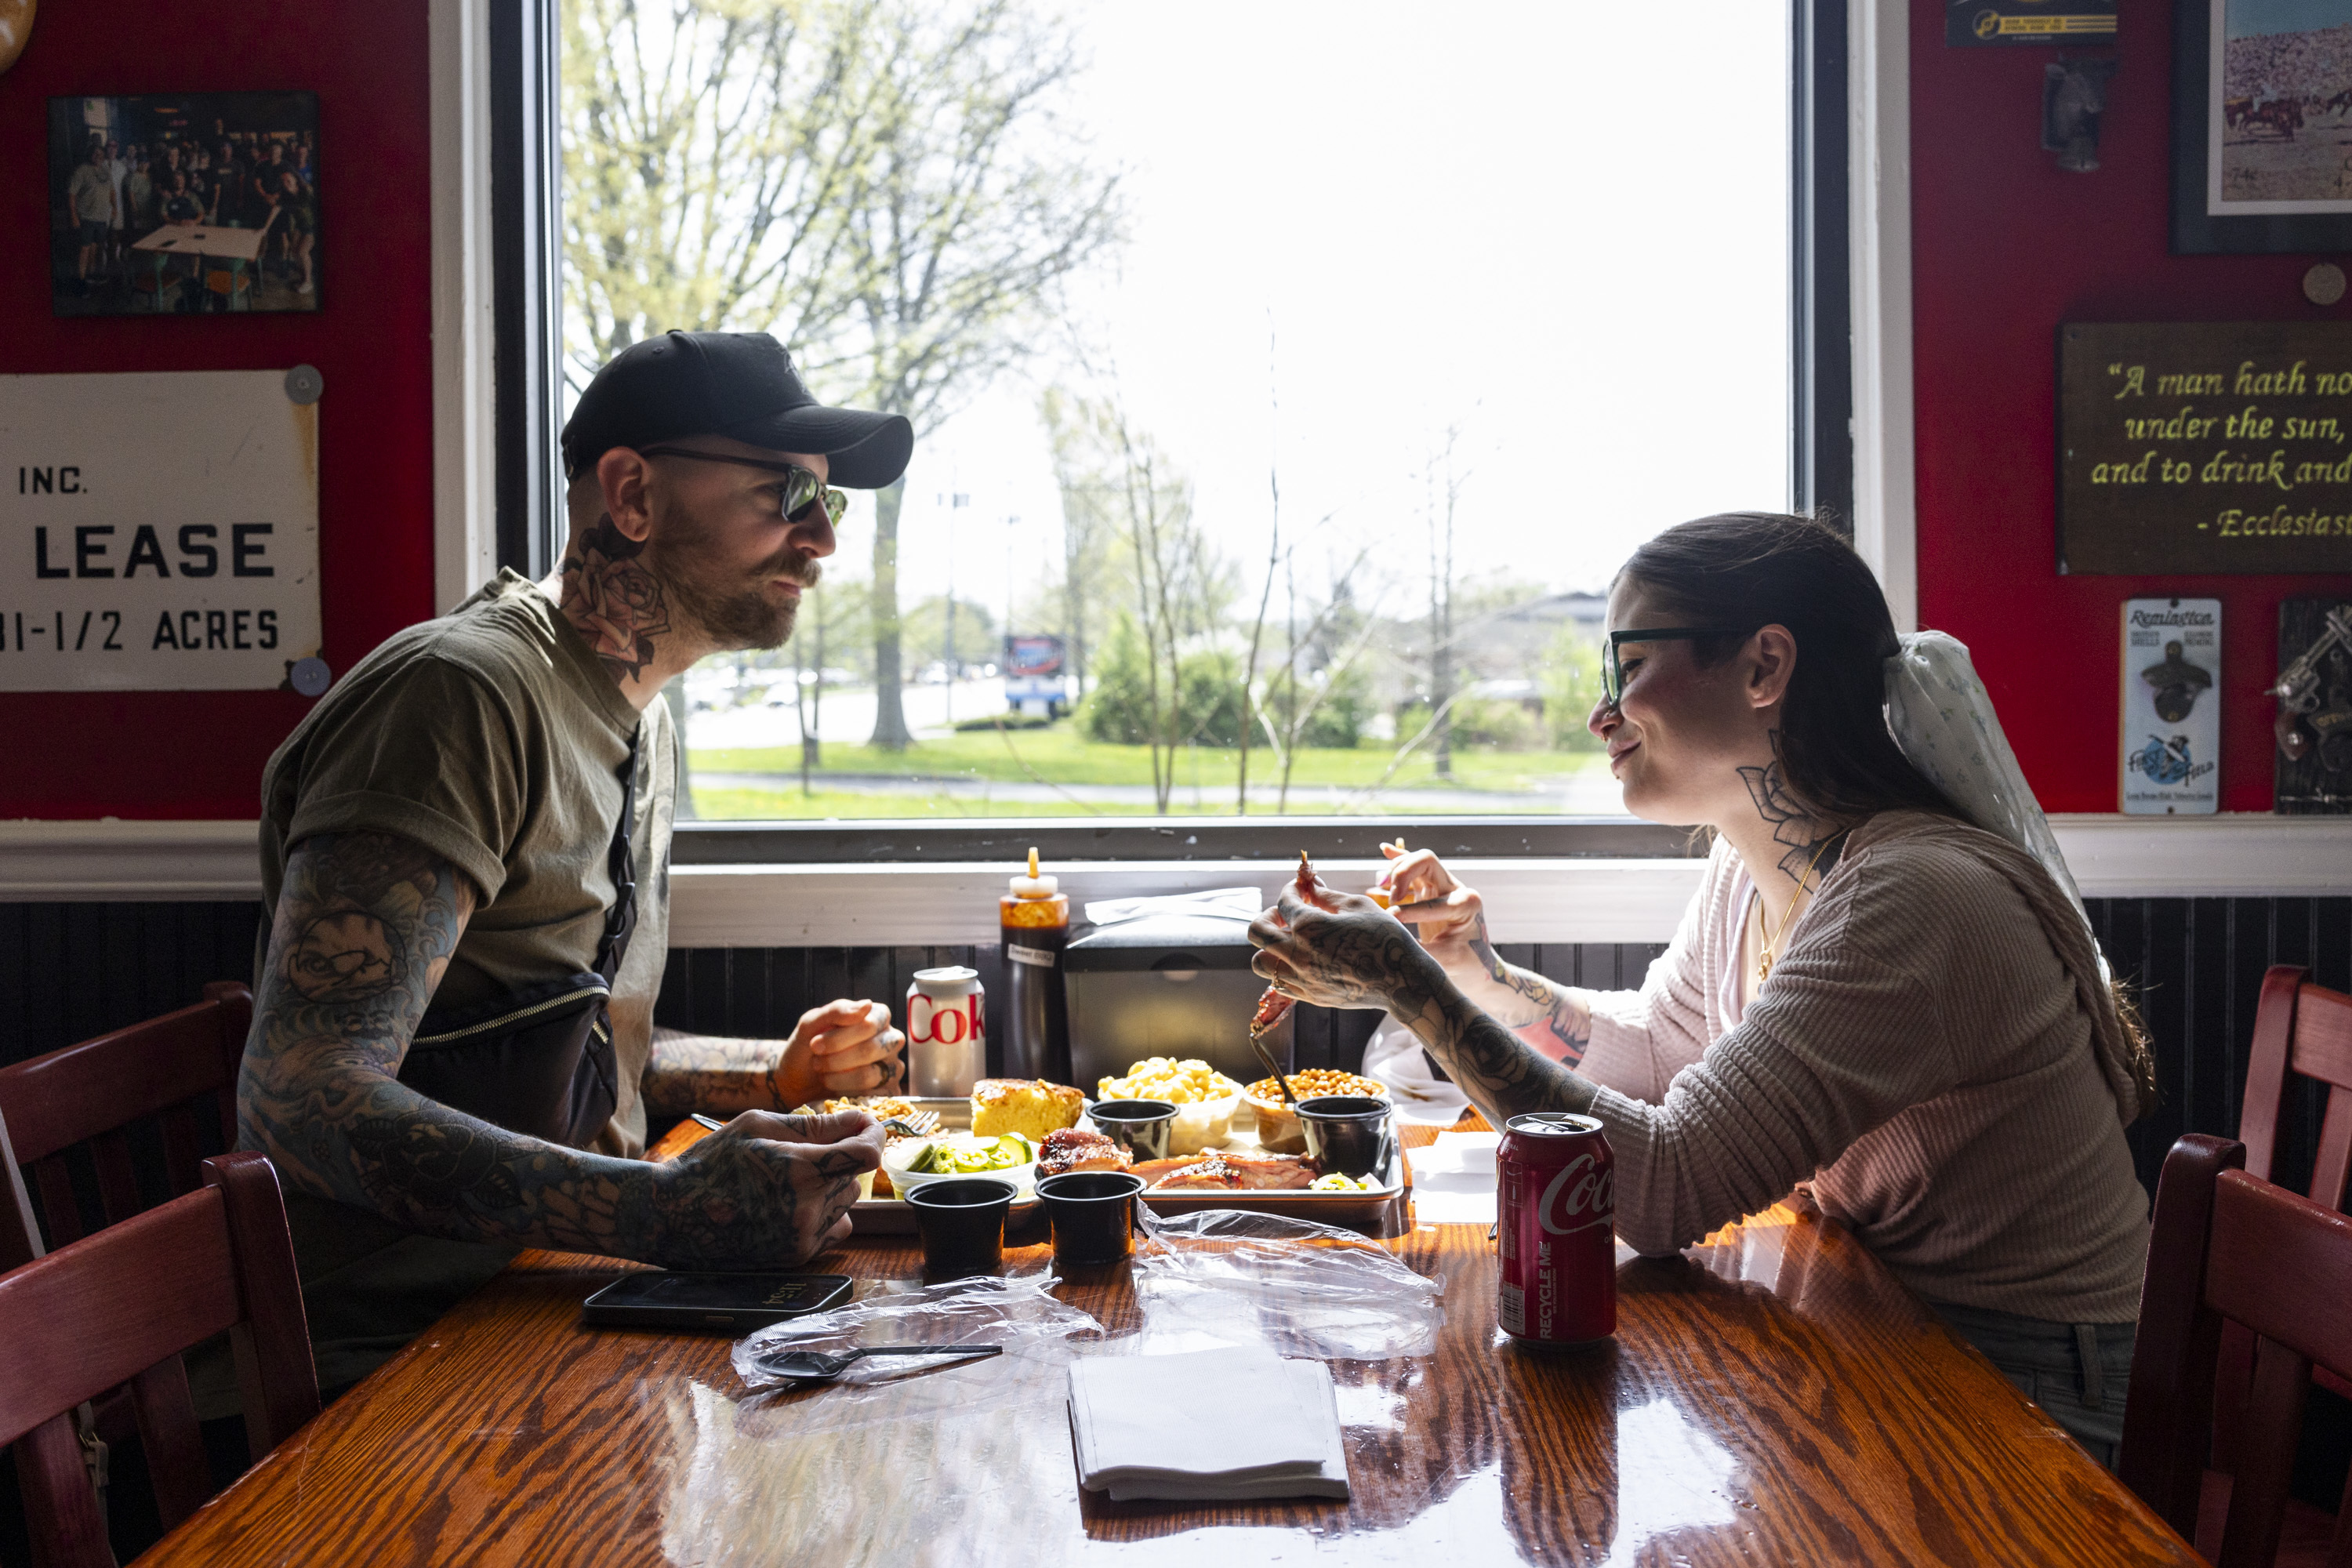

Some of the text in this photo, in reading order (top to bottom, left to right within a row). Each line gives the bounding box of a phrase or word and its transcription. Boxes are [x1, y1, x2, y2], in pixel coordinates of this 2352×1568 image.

[2157, 372, 2224, 396] man
[2234, 361, 2307, 397] hath
[2125, 406, 2345, 444] under the sun,
[19, 467, 88, 495] INC.
[2092, 450, 2352, 490] and to drink and
[35, 523, 275, 579] LEASE
[0, 610, 278, 652] 1-1/2 ACRES
[1539, 1241, 1552, 1340] RECYCLE ME
